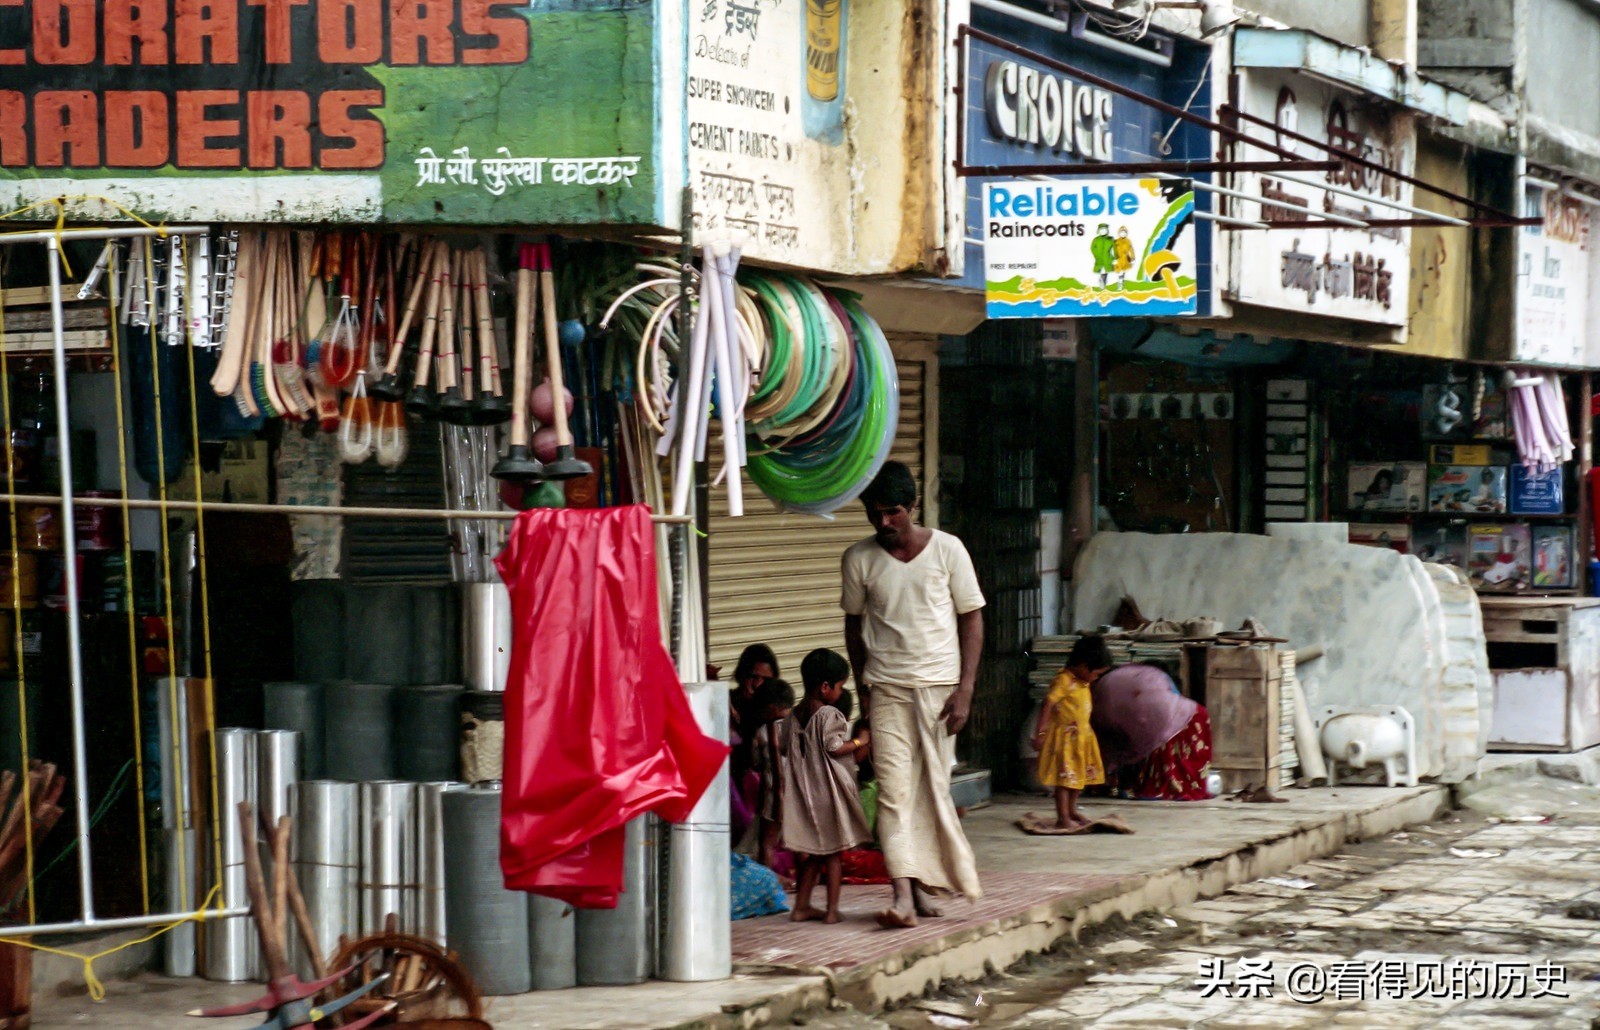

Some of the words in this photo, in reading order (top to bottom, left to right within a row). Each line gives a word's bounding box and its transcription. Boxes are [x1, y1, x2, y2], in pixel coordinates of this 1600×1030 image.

[689, 76, 722, 102] SUPER
[726, 84, 776, 112] SNOWCEM
[987, 60, 1113, 162] CHOICE
[689, 121, 734, 153] CEMENT
[739, 129, 779, 160] PAINTS
[481, 147, 548, 196] सुरेखा
[548, 156, 642, 188] काटकर
[989, 186, 1139, 218] Reliable
[989, 221, 1085, 238] Raincoats
